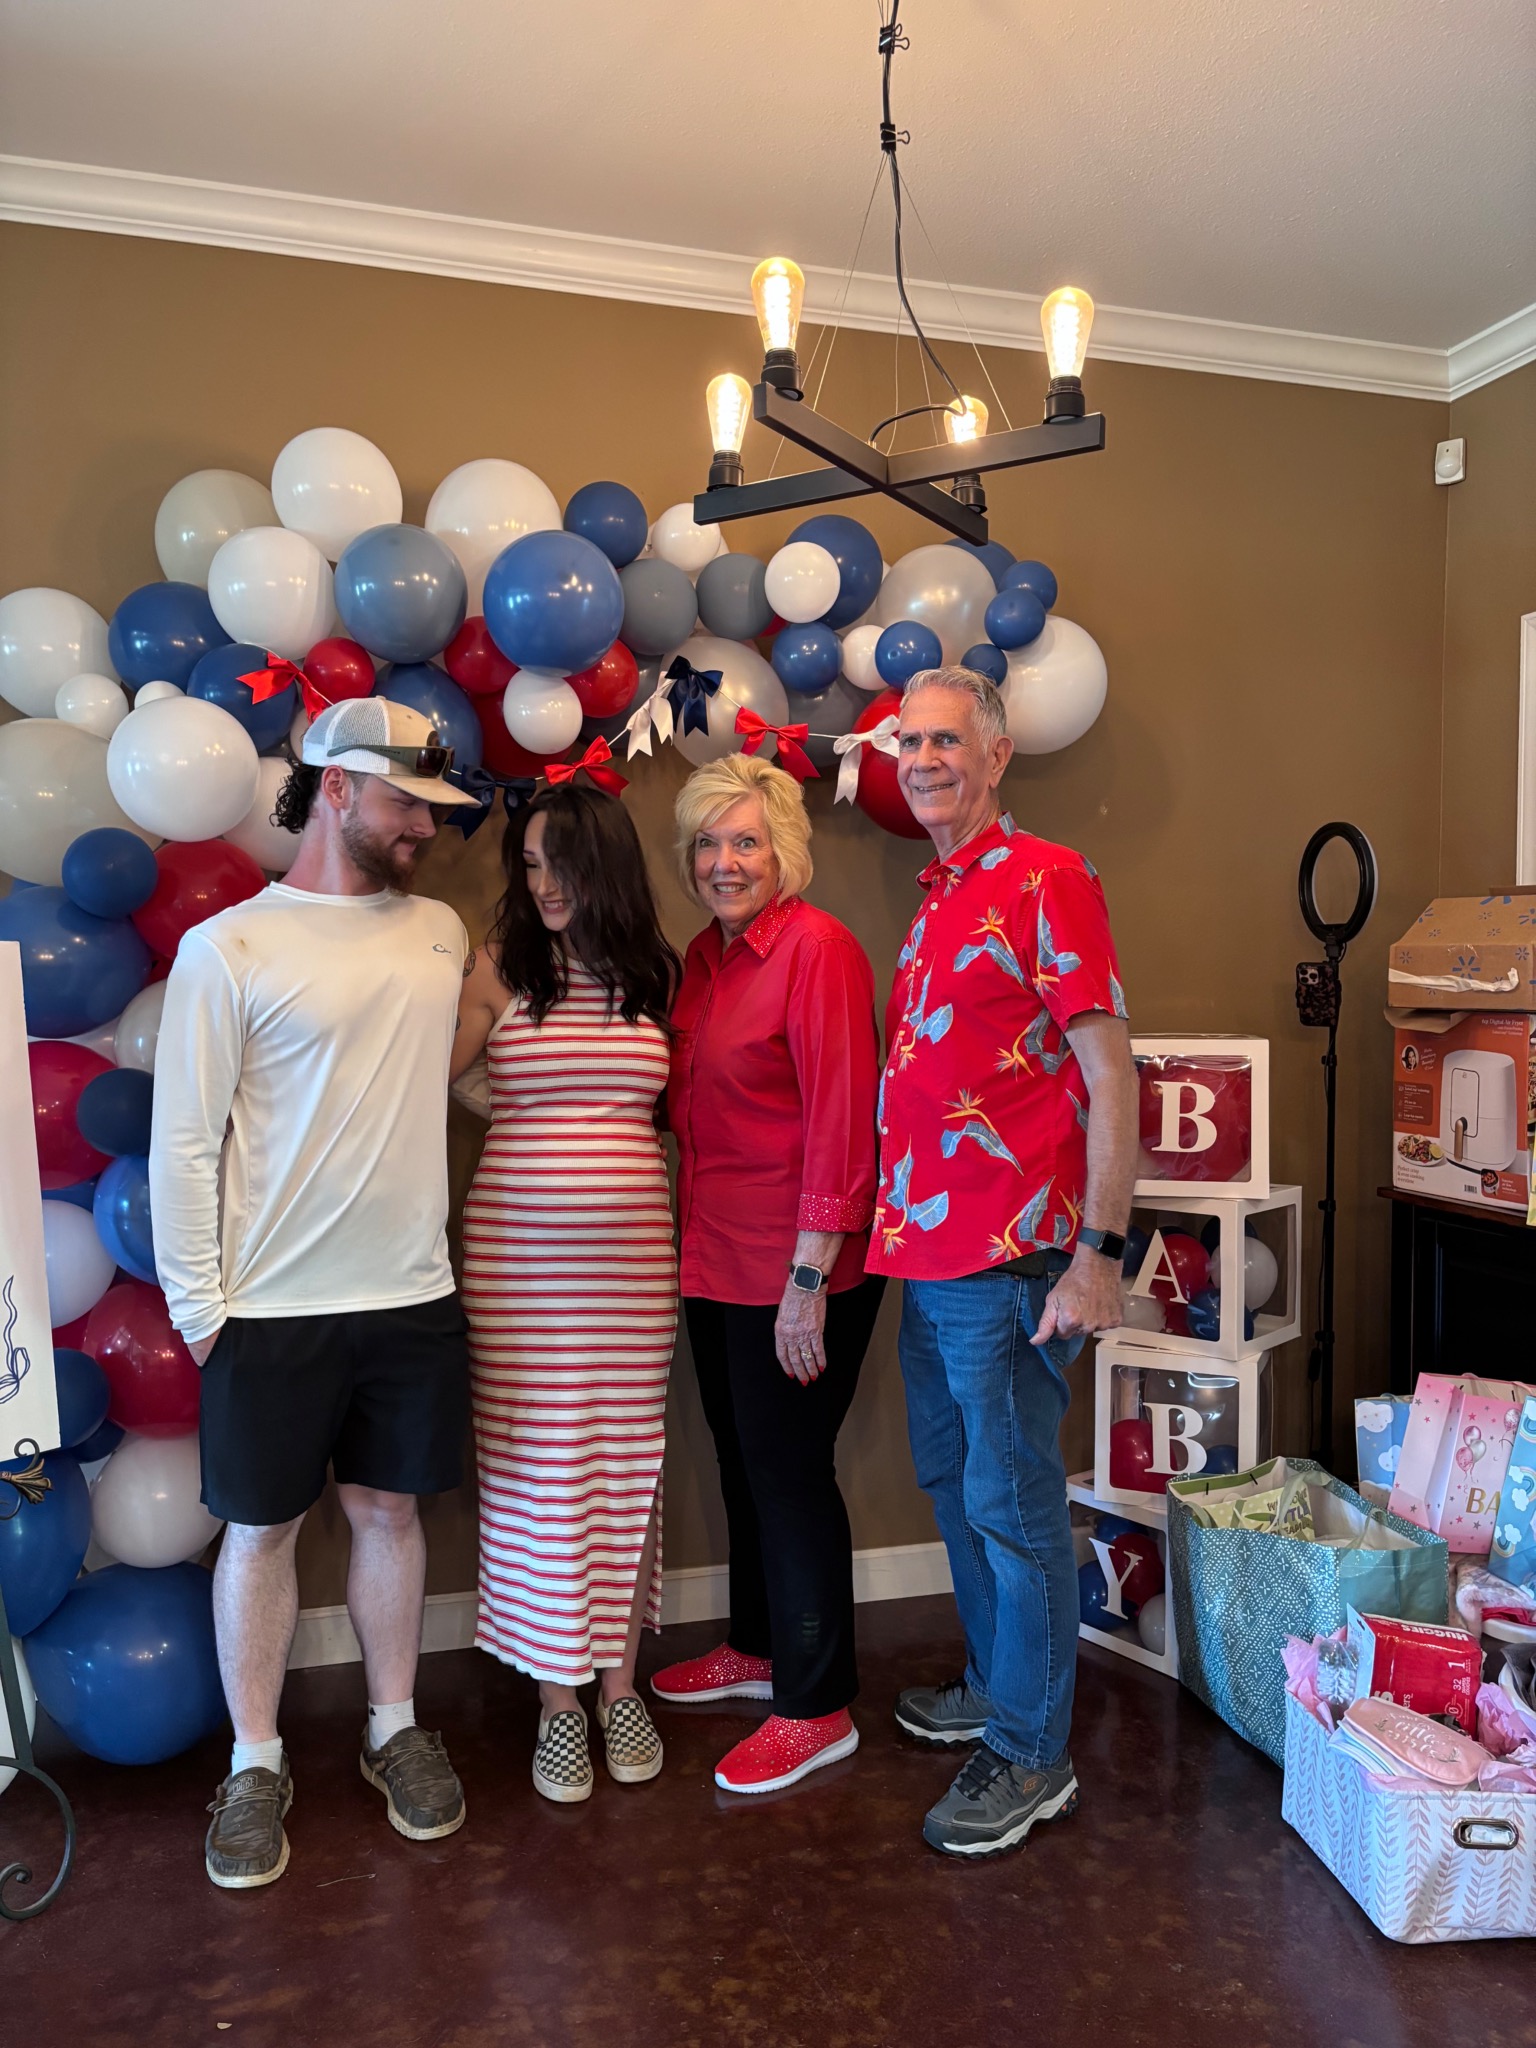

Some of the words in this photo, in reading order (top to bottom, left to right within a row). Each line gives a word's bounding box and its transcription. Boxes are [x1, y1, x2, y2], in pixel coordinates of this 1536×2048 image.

[1151, 1081, 1218, 1153] B
[1126, 1228, 1189, 1305] A
[1142, 1402, 1208, 1476] B
[1088, 1537, 1144, 1620] Y
[1401, 1623, 1470, 1642] HUGGIES
[1448, 1661, 1466, 1670] 1
[1452, 1678, 1462, 1691] 32
